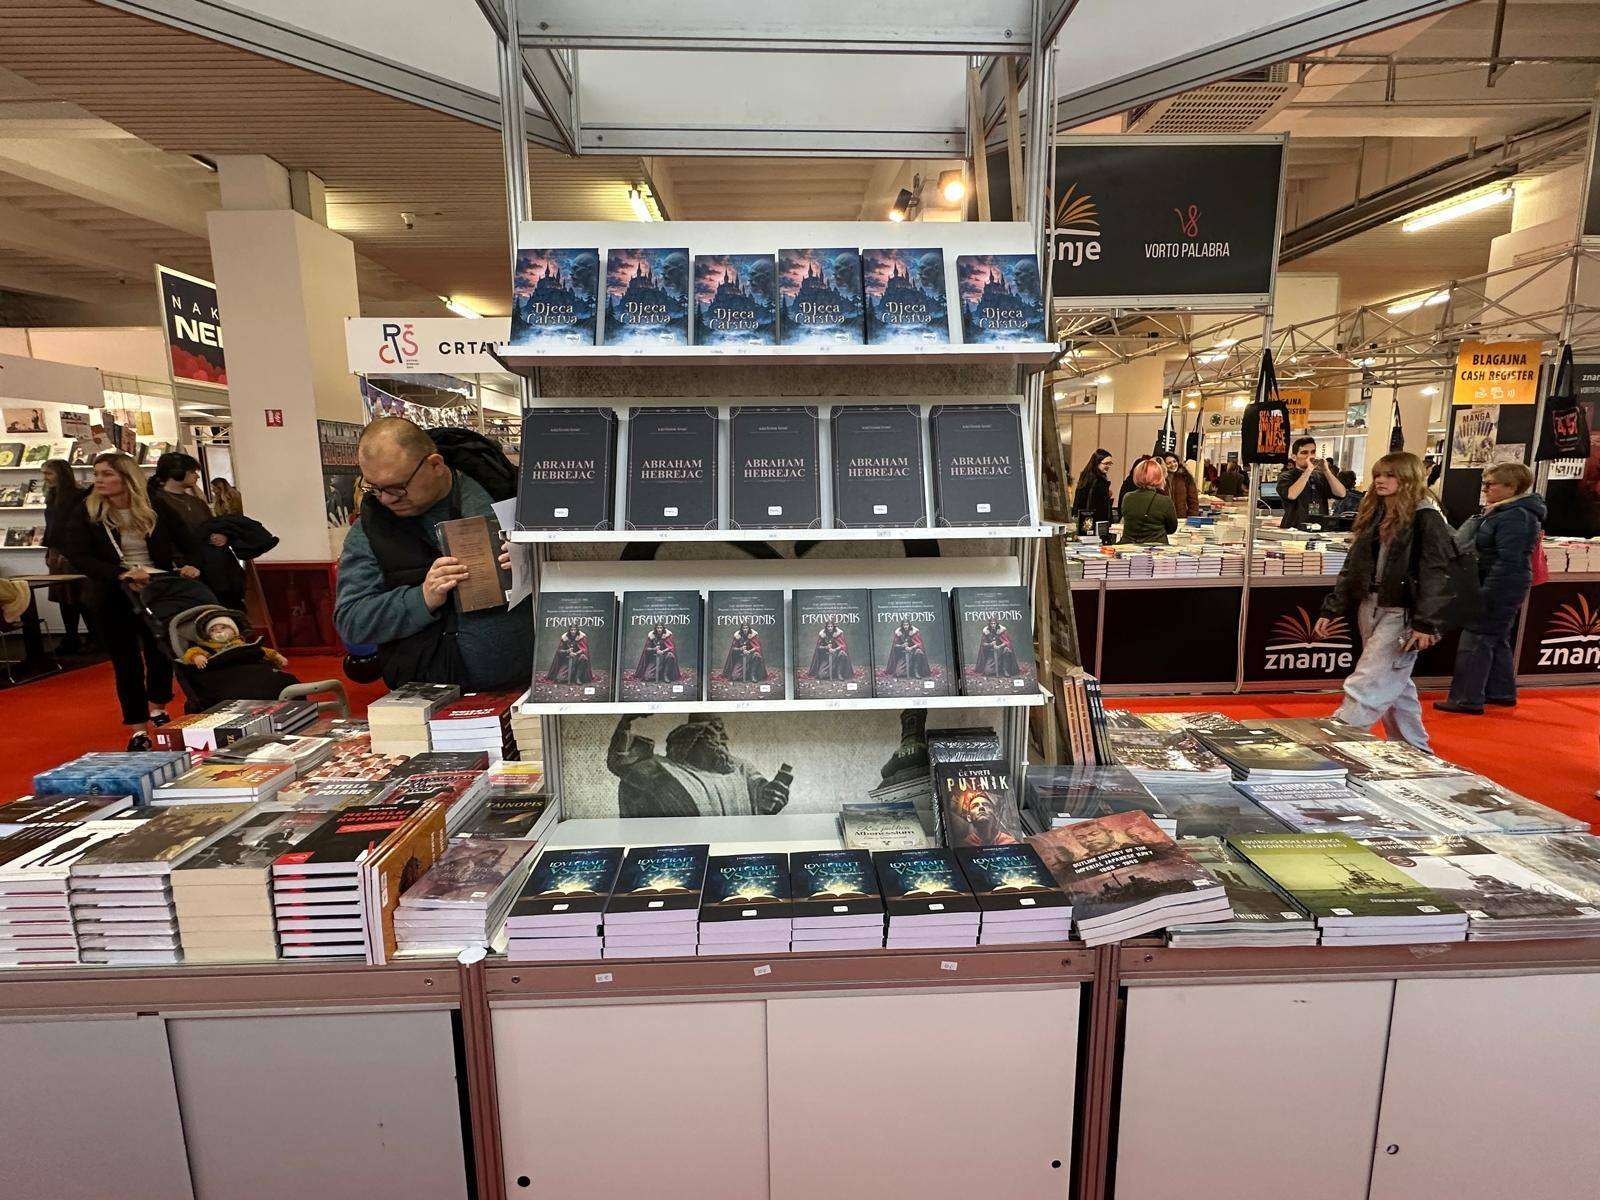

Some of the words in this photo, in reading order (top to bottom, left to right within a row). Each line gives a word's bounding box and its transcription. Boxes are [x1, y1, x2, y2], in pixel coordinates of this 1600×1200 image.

[1145, 242, 1179, 258] VORTO
[1182, 242, 1230, 258] PALABRA
[171, 294, 219, 320] NAK
[532, 302, 573, 316] Djeca
[626, 302, 666, 315] Djeca
[799, 302, 840, 315] Djeca
[886, 302, 926, 315] Djeca
[714, 308, 754, 322] Djeca
[982, 308, 1023, 320] Djeca
[438, 341, 511, 355] CRTA
[1472, 353, 1527, 366] BLAGAJNA
[1461, 370, 1485, 381] CASH
[1488, 370, 1534, 381] REGISTER
[1462, 411, 1491, 423] MANGA
[534, 460, 594, 470] ABRAHAM
[642, 460, 702, 468] ABRAHAM
[744, 458, 804, 468] ABRAHAM
[848, 457, 908, 466] ABRAHAM
[950, 456, 1010, 466] ABRAHAM
[532, 470, 596, 480] HEBREJAC
[641, 470, 703, 479] HEBREJAC
[744, 468, 806, 478] HEBREJAC
[848, 467, 910, 477] HEBREJAC
[950, 466, 1012, 476] HEBREJAC
[545, 616, 605, 628] PRAVEDNIK
[632, 614, 691, 626] PRAVEDNIK
[718, 614, 776, 625] PRAVEDNIK
[801, 612, 860, 624] PRAVEDNIK
[877, 611, 936, 623] PRAVEDNIK
[964, 610, 1023, 622] PRAVEDNIK
[1264, 650, 1353, 673] znanje
[946, 775, 1009, 791] PUTNIK
[1072, 857, 1098, 869] OUTLINE
[1098, 850, 1124, 861] HISTORY
[1074, 862, 1104, 874] IMPERIAL
[1105, 854, 1135, 865] JAPANESE
[1136, 850, 1154, 858] NAVY
